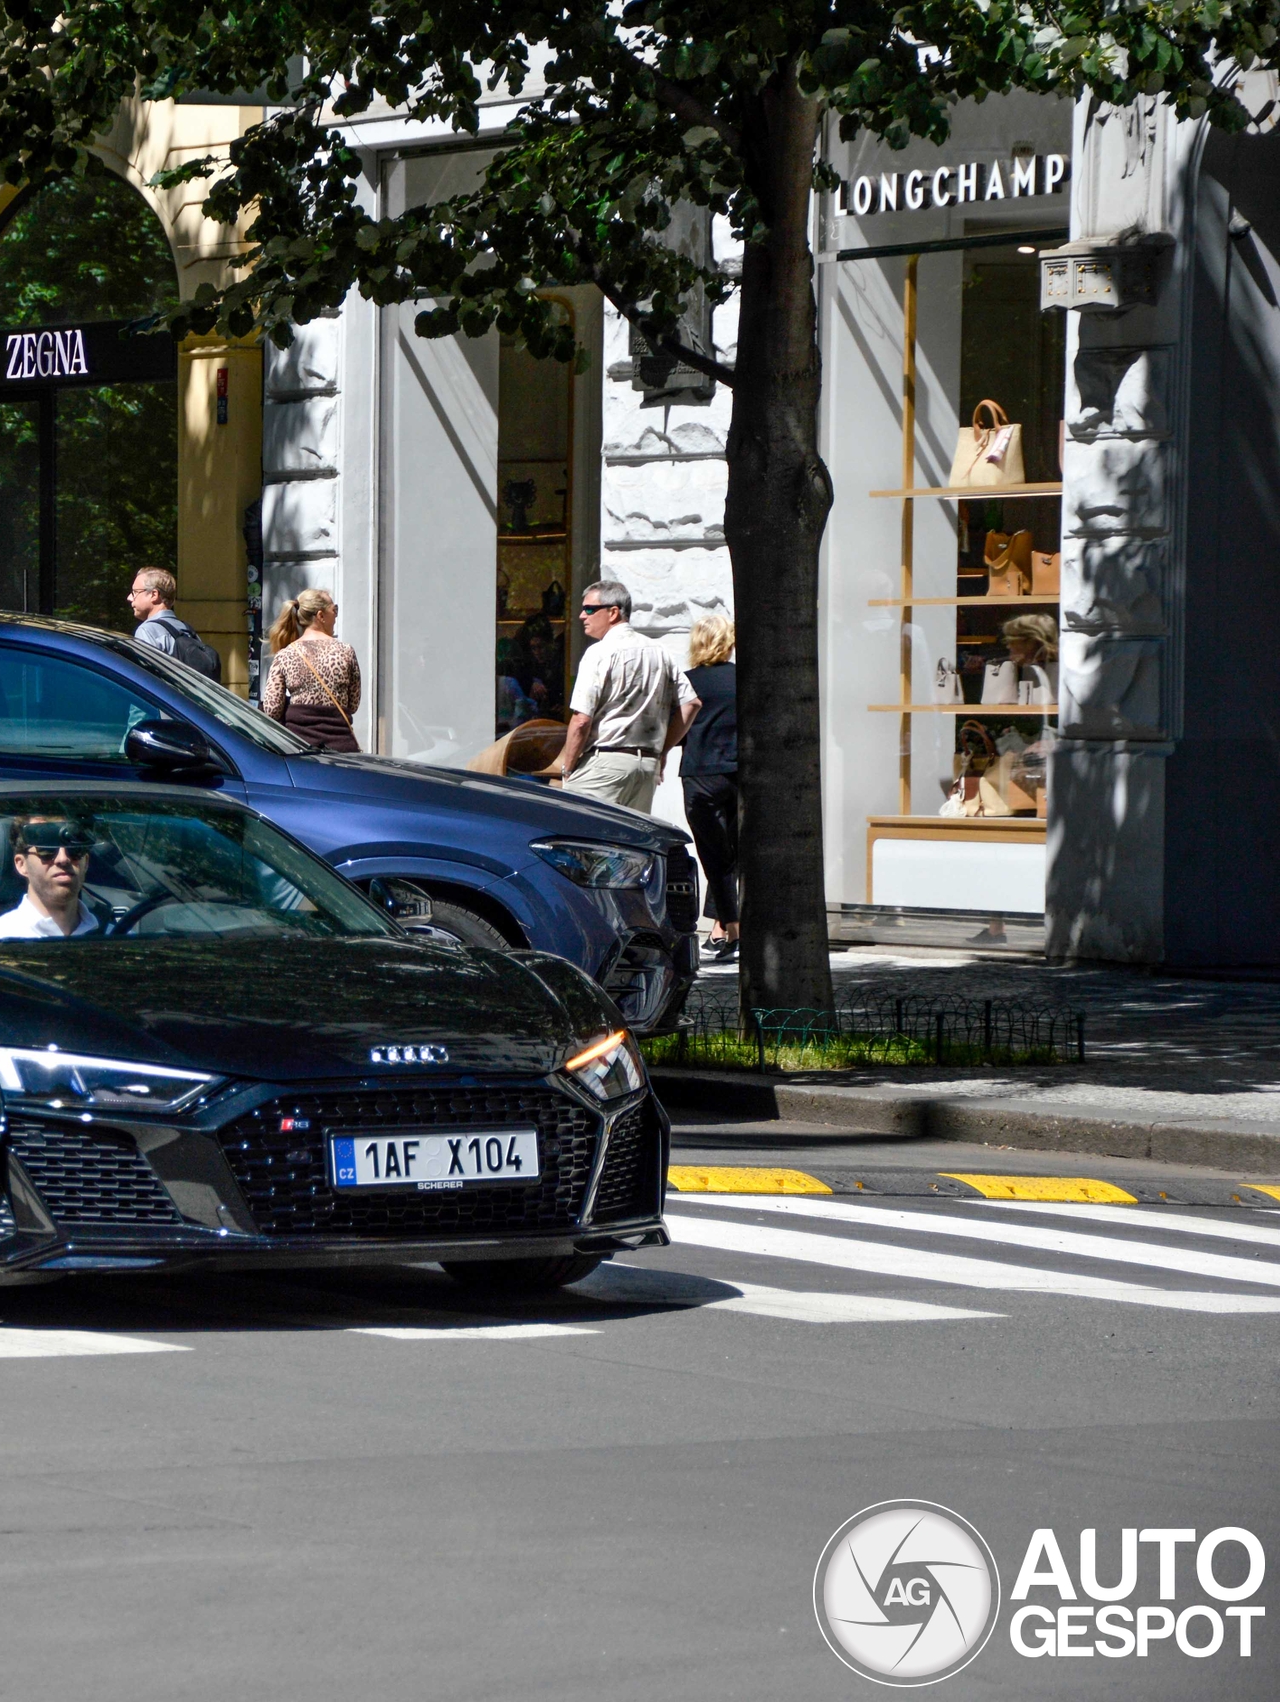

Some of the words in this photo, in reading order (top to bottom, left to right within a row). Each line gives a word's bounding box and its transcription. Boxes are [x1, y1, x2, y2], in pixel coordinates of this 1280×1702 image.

[833, 153, 1065, 217] LONGCHAMP
[6, 329, 89, 380] ZEGNA
[339, 1168, 355, 1180] CZ
[364, 1140, 420, 1178] 1AF
[447, 1135, 522, 1175] X104
[417, 1180, 464, 1190] SCHERER
